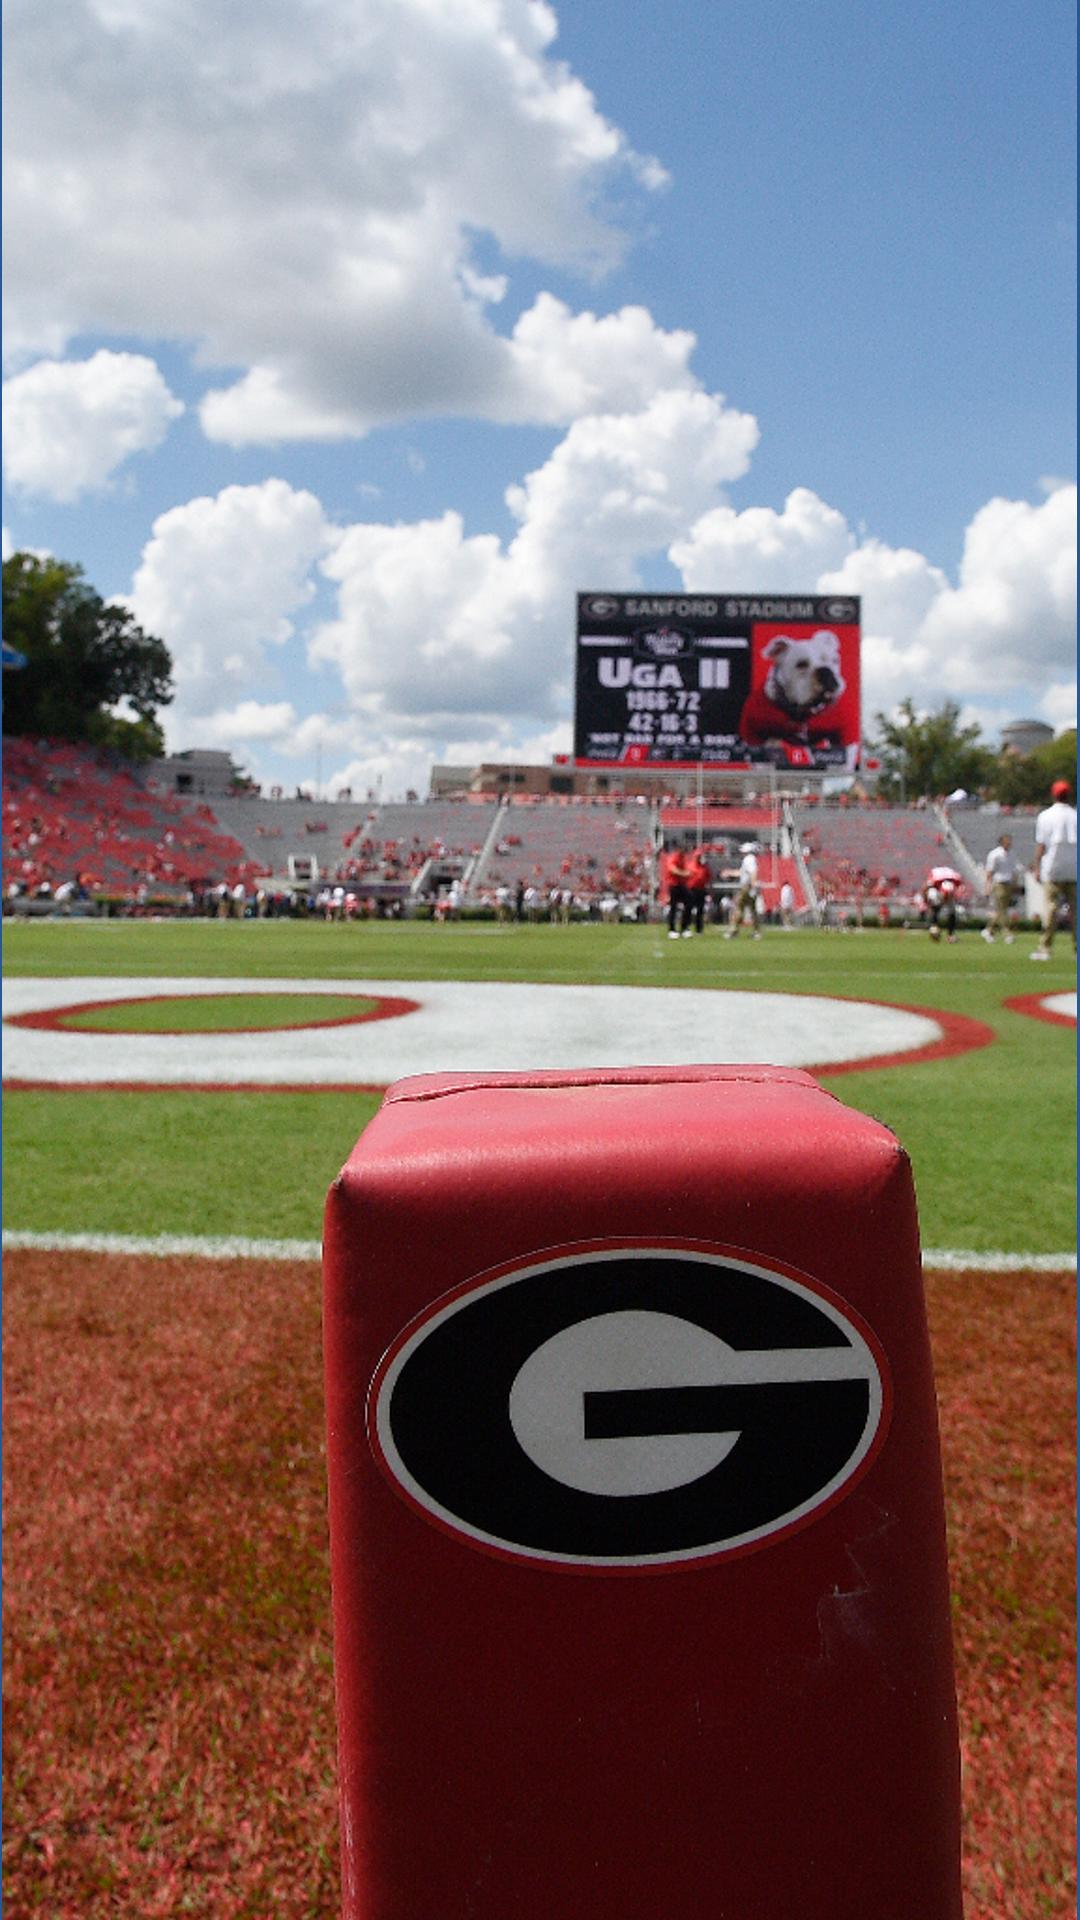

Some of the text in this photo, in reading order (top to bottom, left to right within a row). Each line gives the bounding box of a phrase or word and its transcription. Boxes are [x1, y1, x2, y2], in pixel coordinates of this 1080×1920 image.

[624, 599, 814, 618] SANFORD STADIUM
[699, 658, 729, 689] II
[389, 1257, 870, 1557] G
